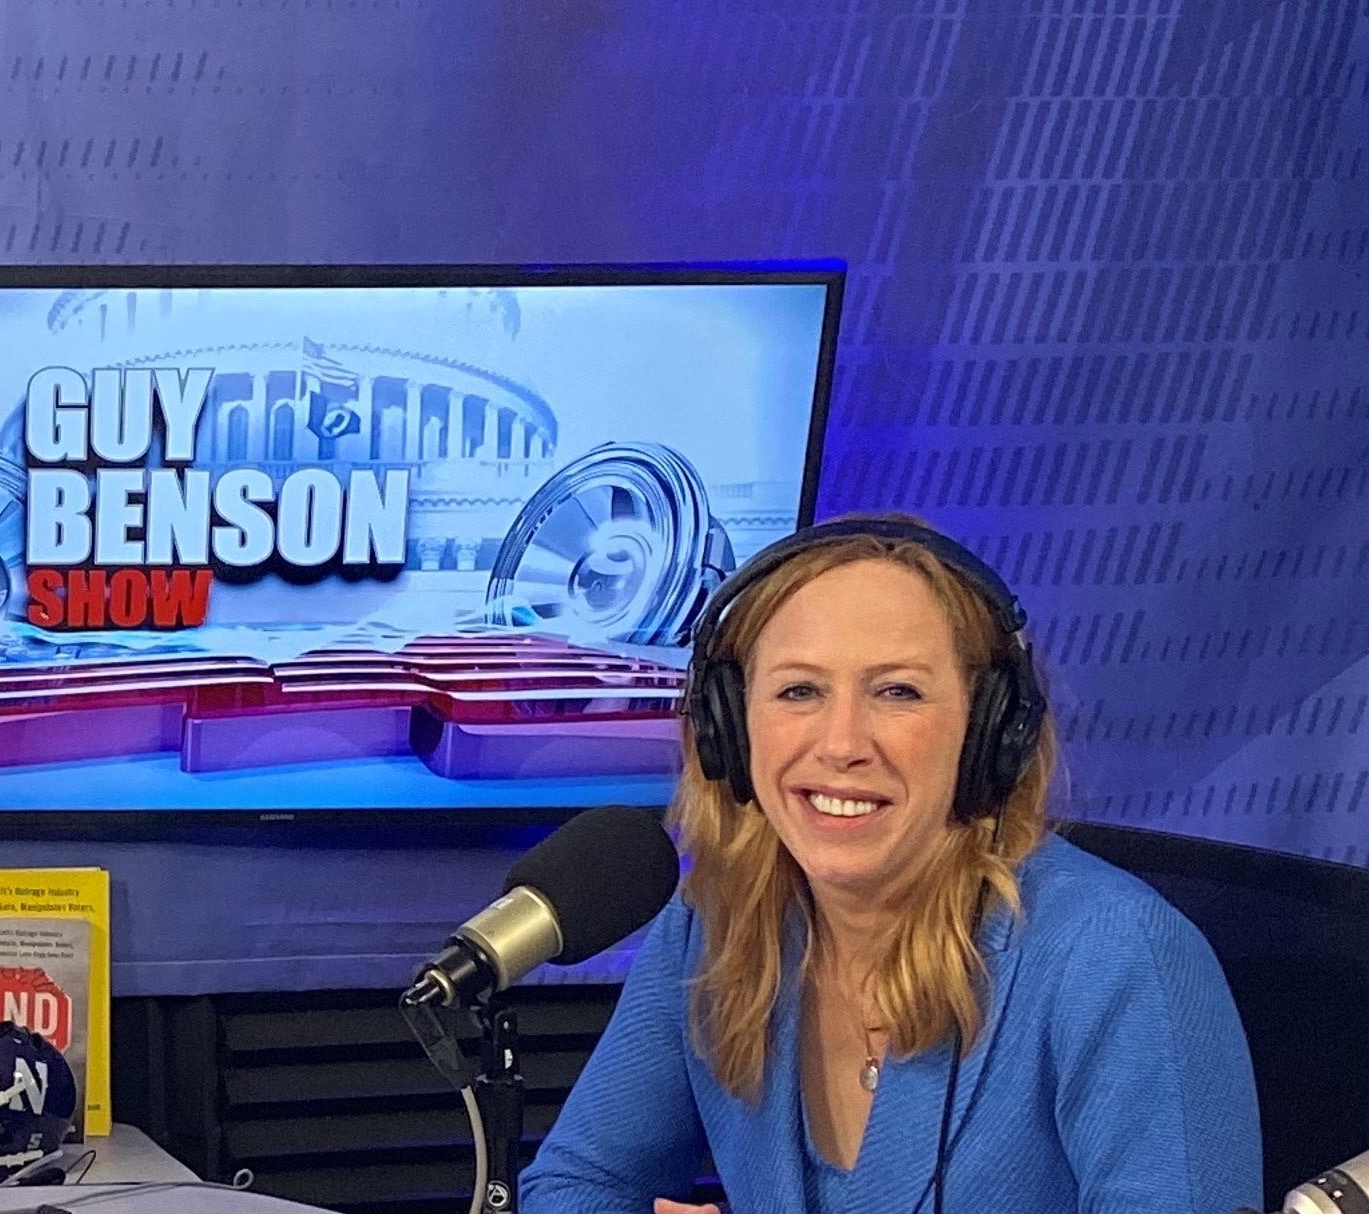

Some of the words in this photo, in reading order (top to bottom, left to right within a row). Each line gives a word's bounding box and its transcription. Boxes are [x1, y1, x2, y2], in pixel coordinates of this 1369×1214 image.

[26, 366, 215, 462] GUY
[27, 468, 409, 566] BENSON
[28, 569, 212, 628] SHOW
[9, 1058, 48, 1115] N
